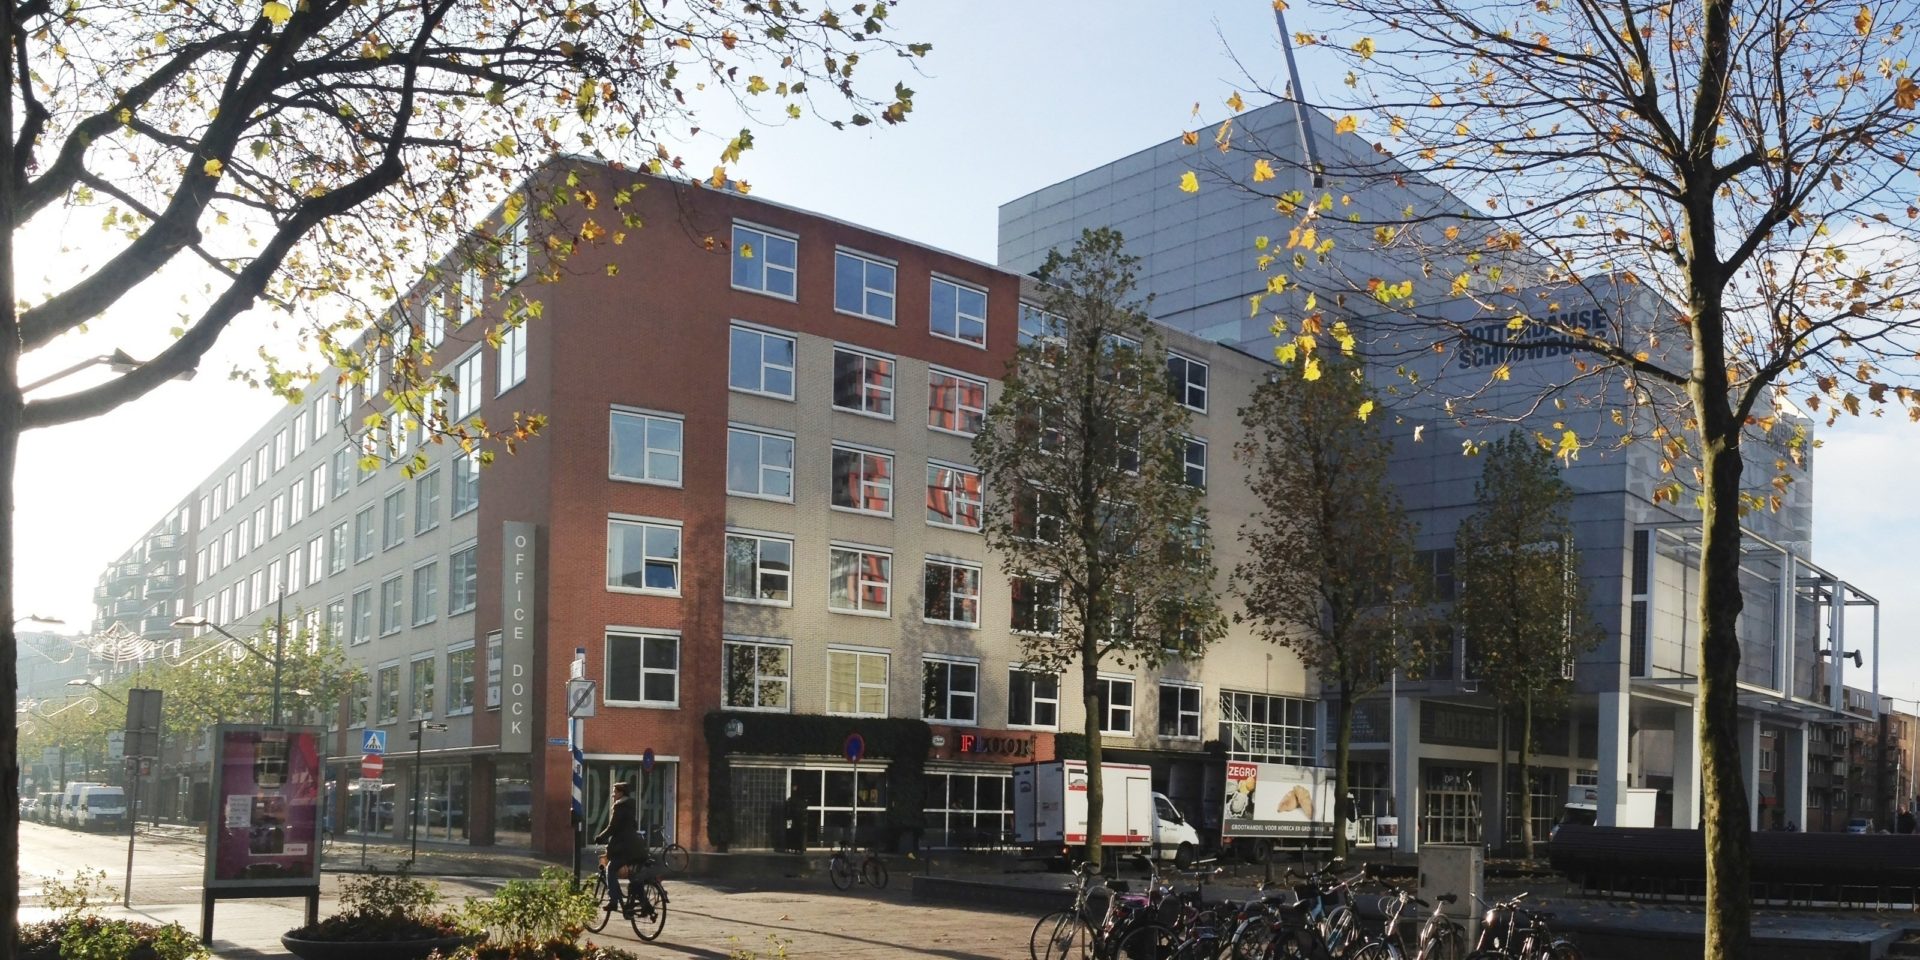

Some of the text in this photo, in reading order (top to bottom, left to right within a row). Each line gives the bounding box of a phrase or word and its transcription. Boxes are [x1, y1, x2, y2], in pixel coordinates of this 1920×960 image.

[1458, 330, 1607, 369] SCHOUWBU
[511, 535, 527, 734] OFFICE DOCK
[960, 735, 1033, 757] FLOOR
[1228, 765, 1257, 777] ZEGRO
